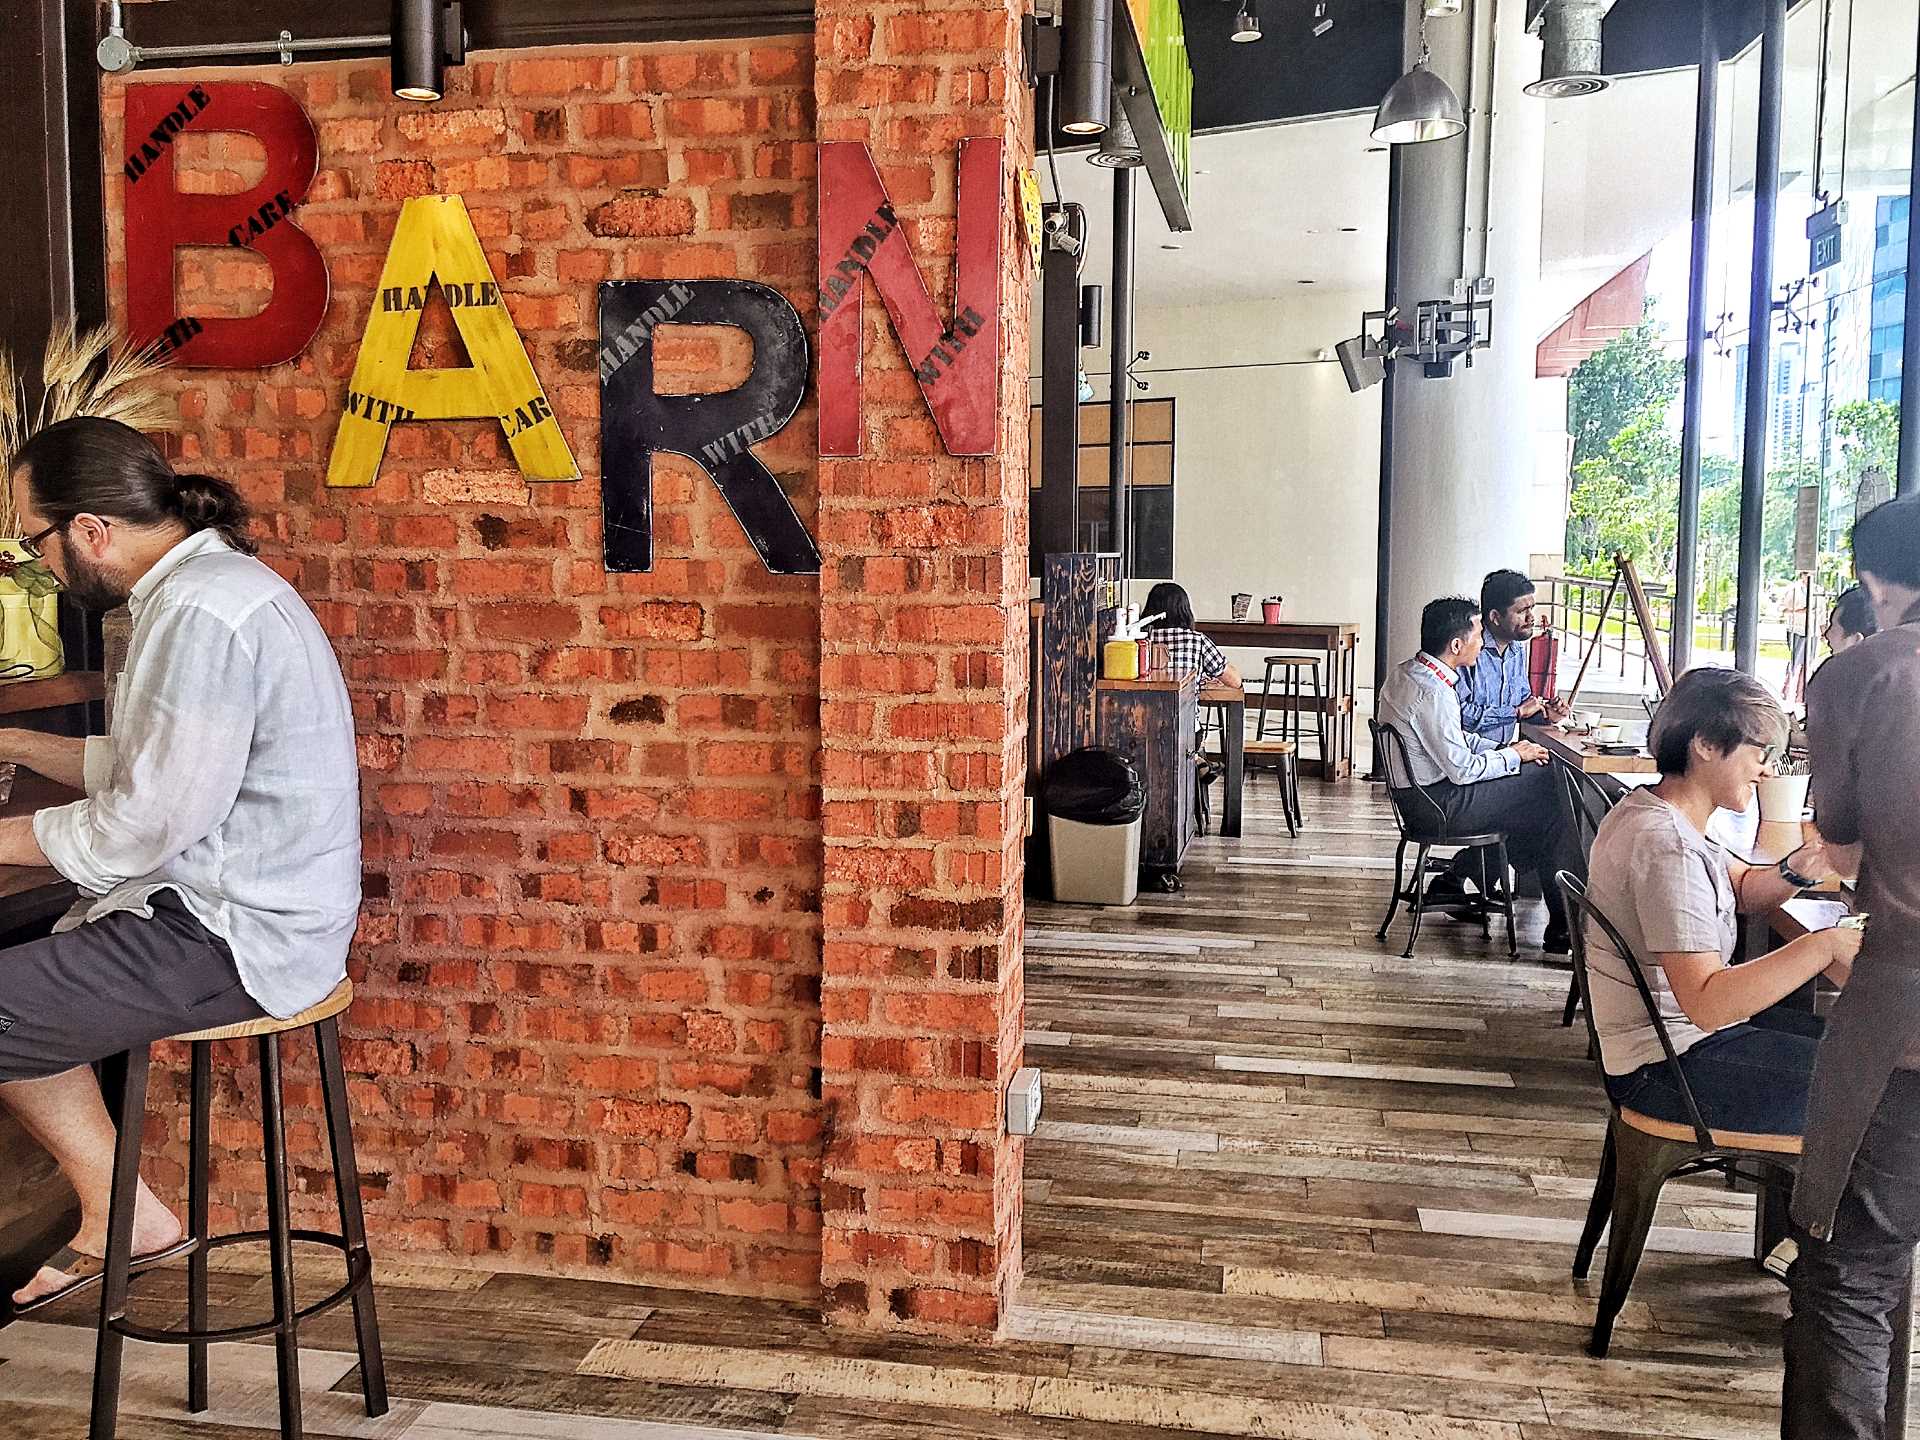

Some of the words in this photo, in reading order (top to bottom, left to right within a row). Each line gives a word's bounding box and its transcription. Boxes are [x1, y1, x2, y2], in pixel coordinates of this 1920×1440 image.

[124, 84, 211, 184] HANDLE
[1815, 234, 1836, 266] EXIT
[125, 80, 1002, 575] BARN
[383, 281, 498, 312] HADLE
